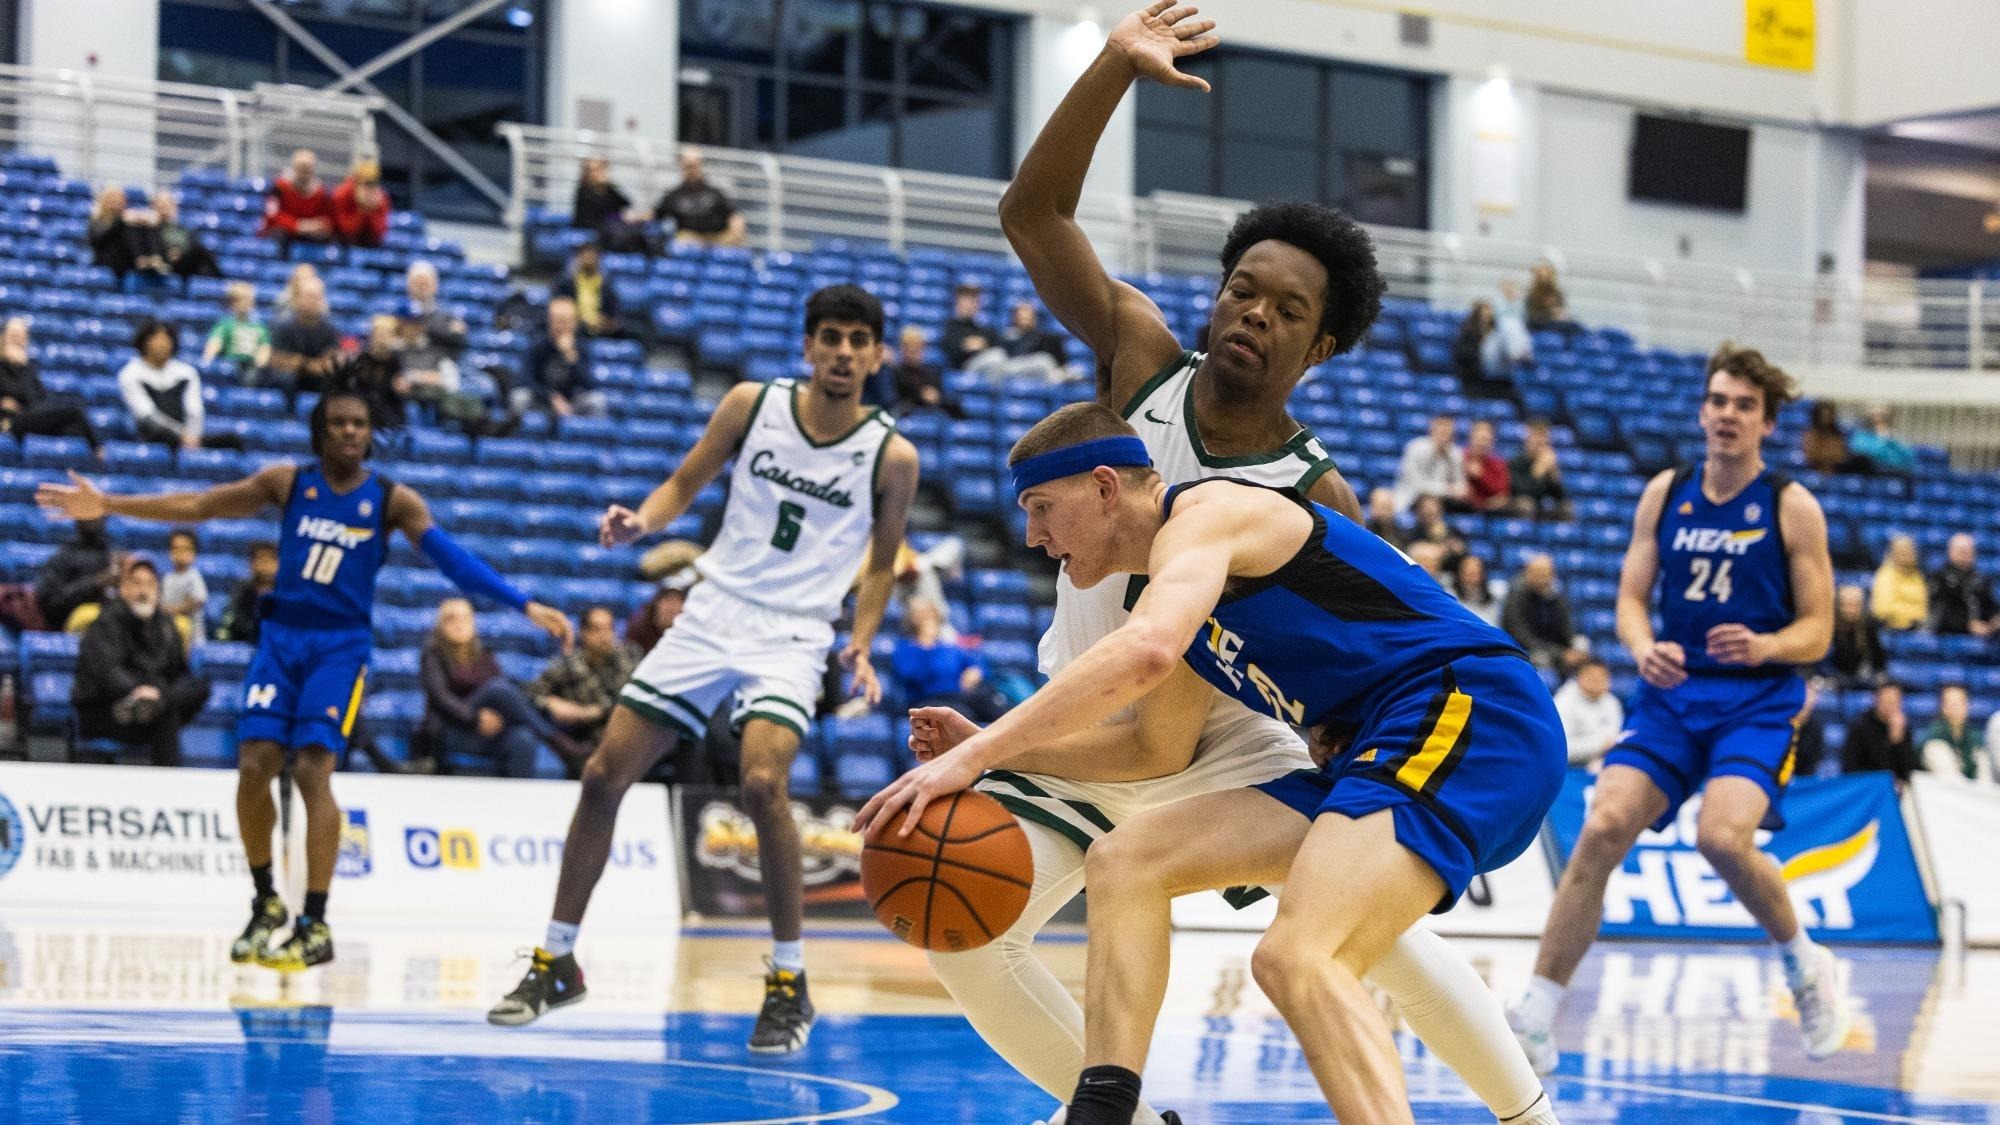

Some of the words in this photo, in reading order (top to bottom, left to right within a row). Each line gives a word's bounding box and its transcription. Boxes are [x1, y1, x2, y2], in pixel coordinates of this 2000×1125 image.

[750, 450, 854, 508] Cascades
[296, 514, 375, 549] HEAT
[771, 500, 806, 552] 6
[1672, 526, 1768, 556] HEAT
[301, 542, 344, 585] 10
[1683, 556, 1733, 604] 24
[27, 804, 233, 842] VERSATIL
[35, 847, 75, 870] FAB
[85, 849, 100, 871] &
[109, 849, 206, 875] MACHINE
